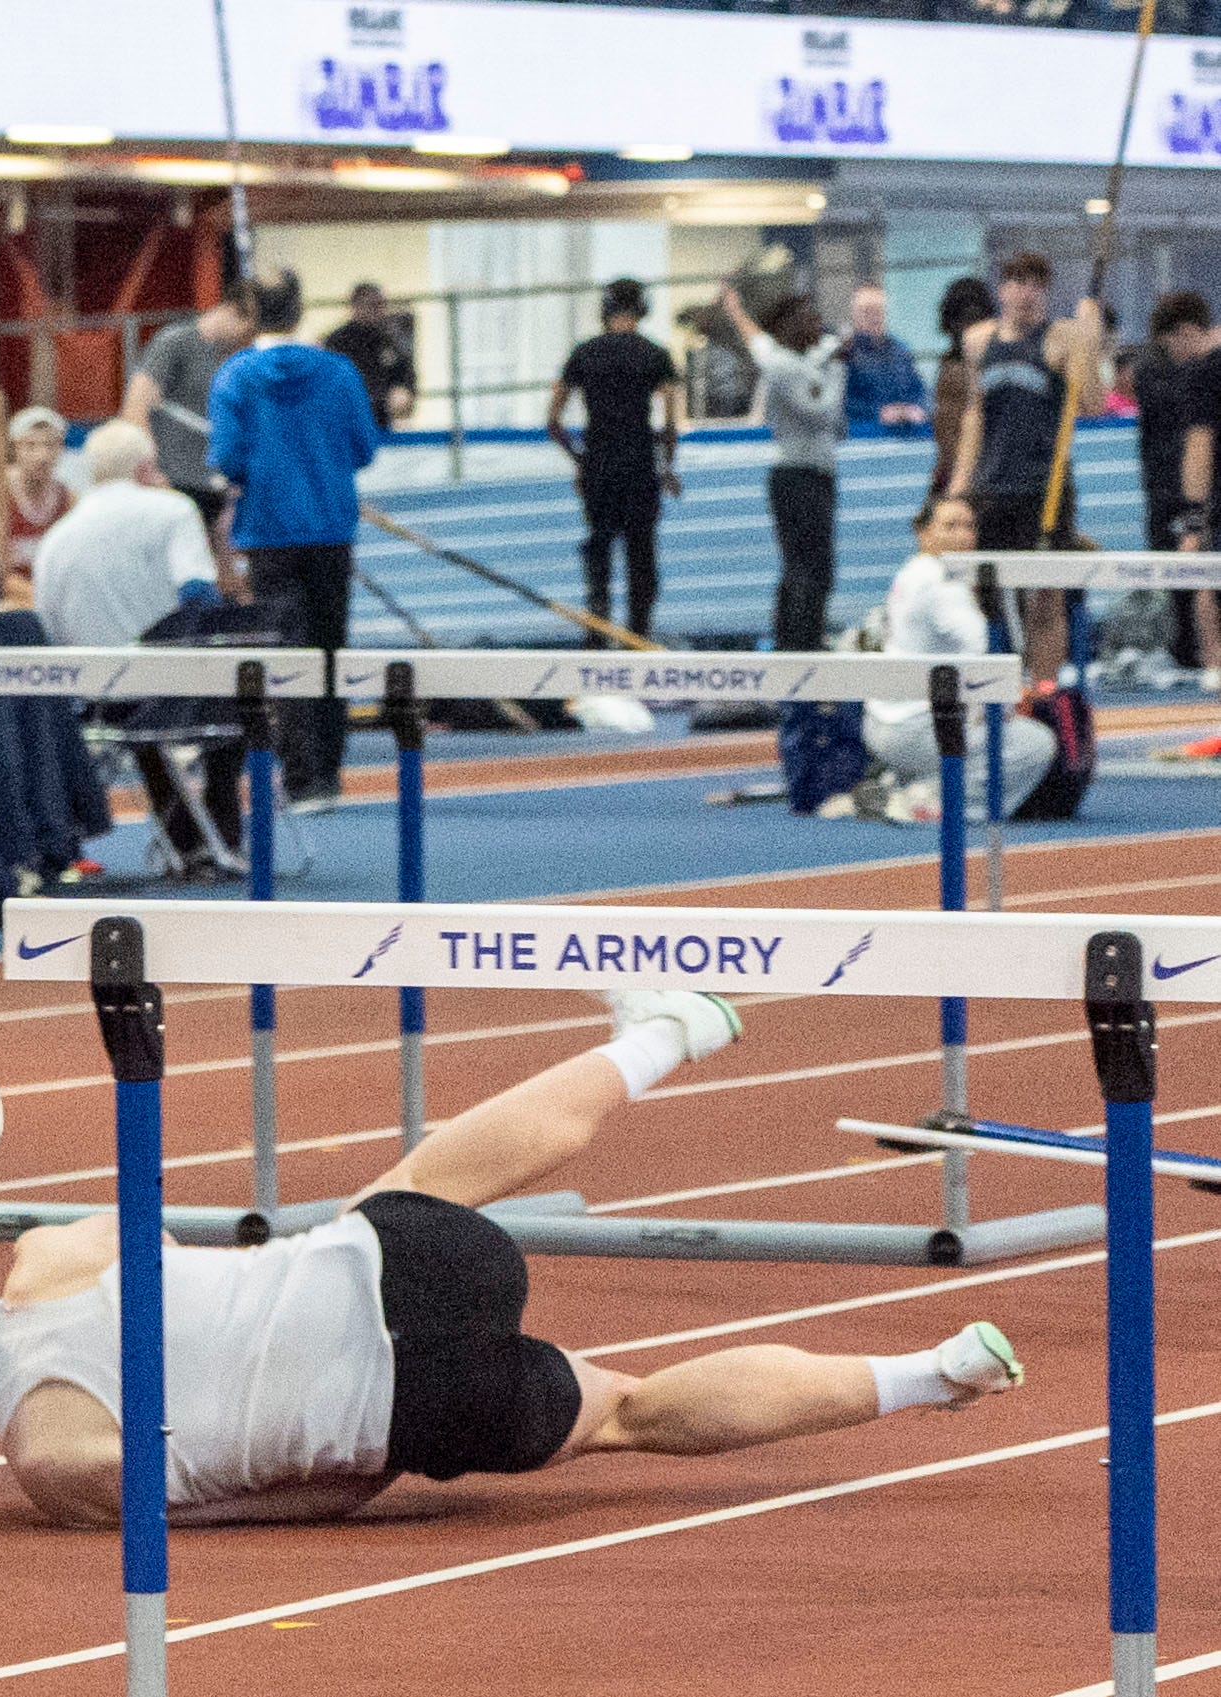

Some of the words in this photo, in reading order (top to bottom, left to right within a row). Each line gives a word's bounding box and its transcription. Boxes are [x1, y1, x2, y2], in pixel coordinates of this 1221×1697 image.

[579, 665, 633, 690] THE
[643, 667, 767, 691] ARMORY
[439, 931, 537, 971] THE
[556, 933, 783, 976] ARMORY
